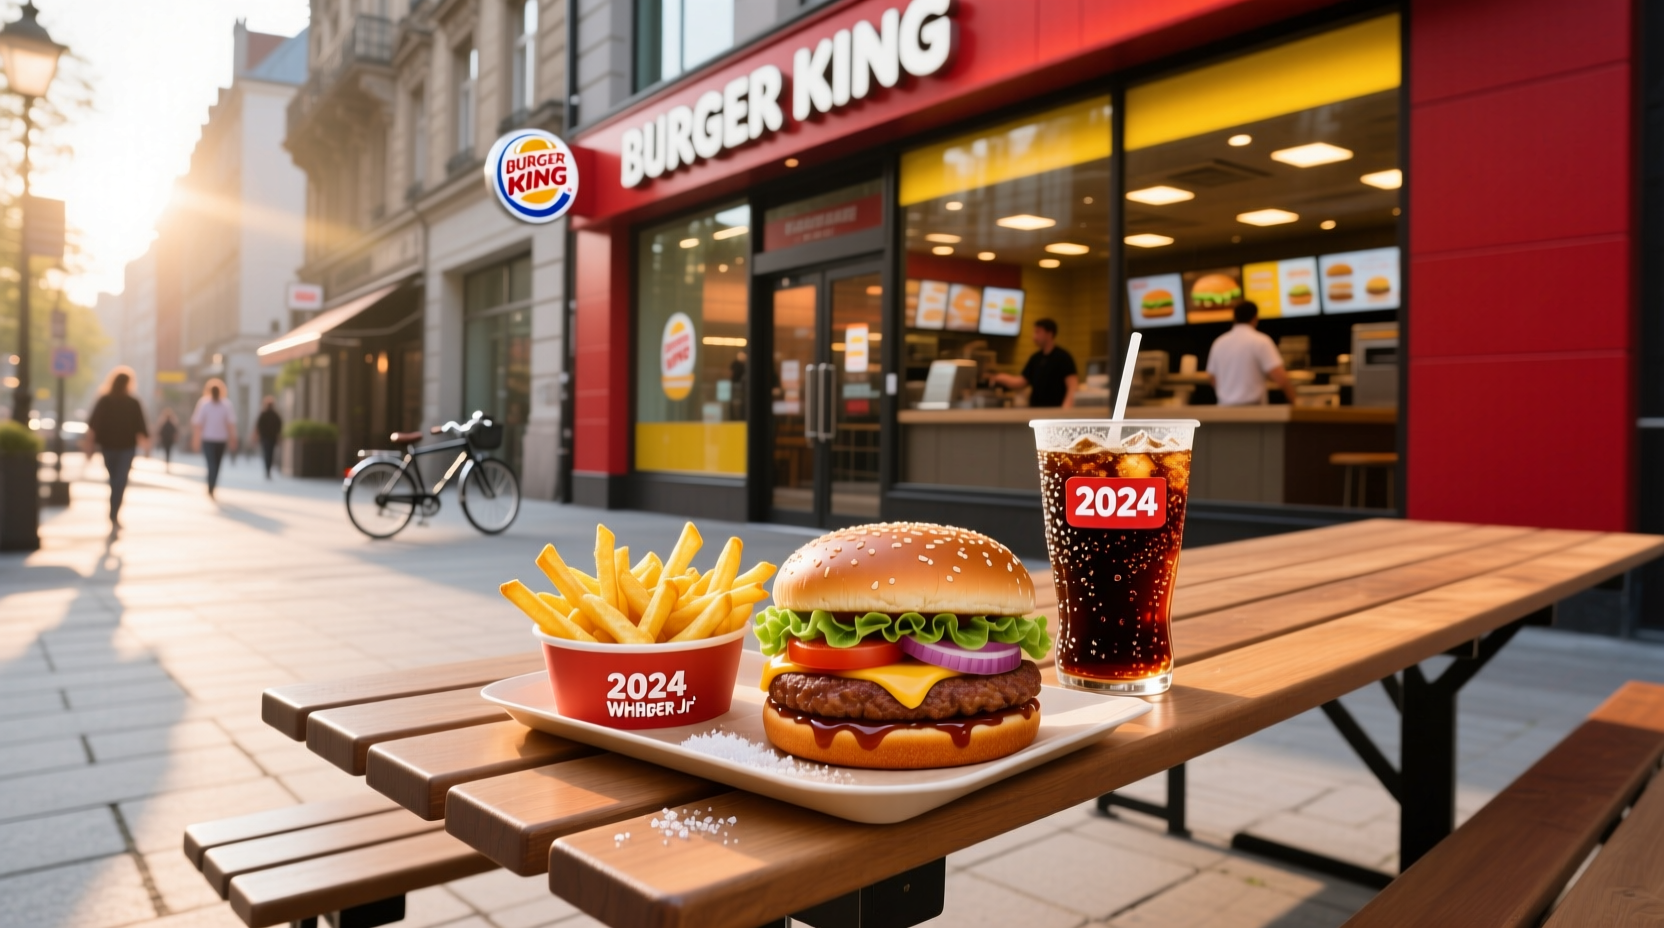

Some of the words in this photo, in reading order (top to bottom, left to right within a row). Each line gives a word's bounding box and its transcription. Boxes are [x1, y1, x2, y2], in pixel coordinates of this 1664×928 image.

[621, 64, 783, 189] BURGER
[793, 0, 951, 121] KING
[506, 153, 565, 174] BURGER
[508, 166, 567, 196] KING
[1075, 486, 1158, 517] 2024
[607, 670, 687, 699] 2024
